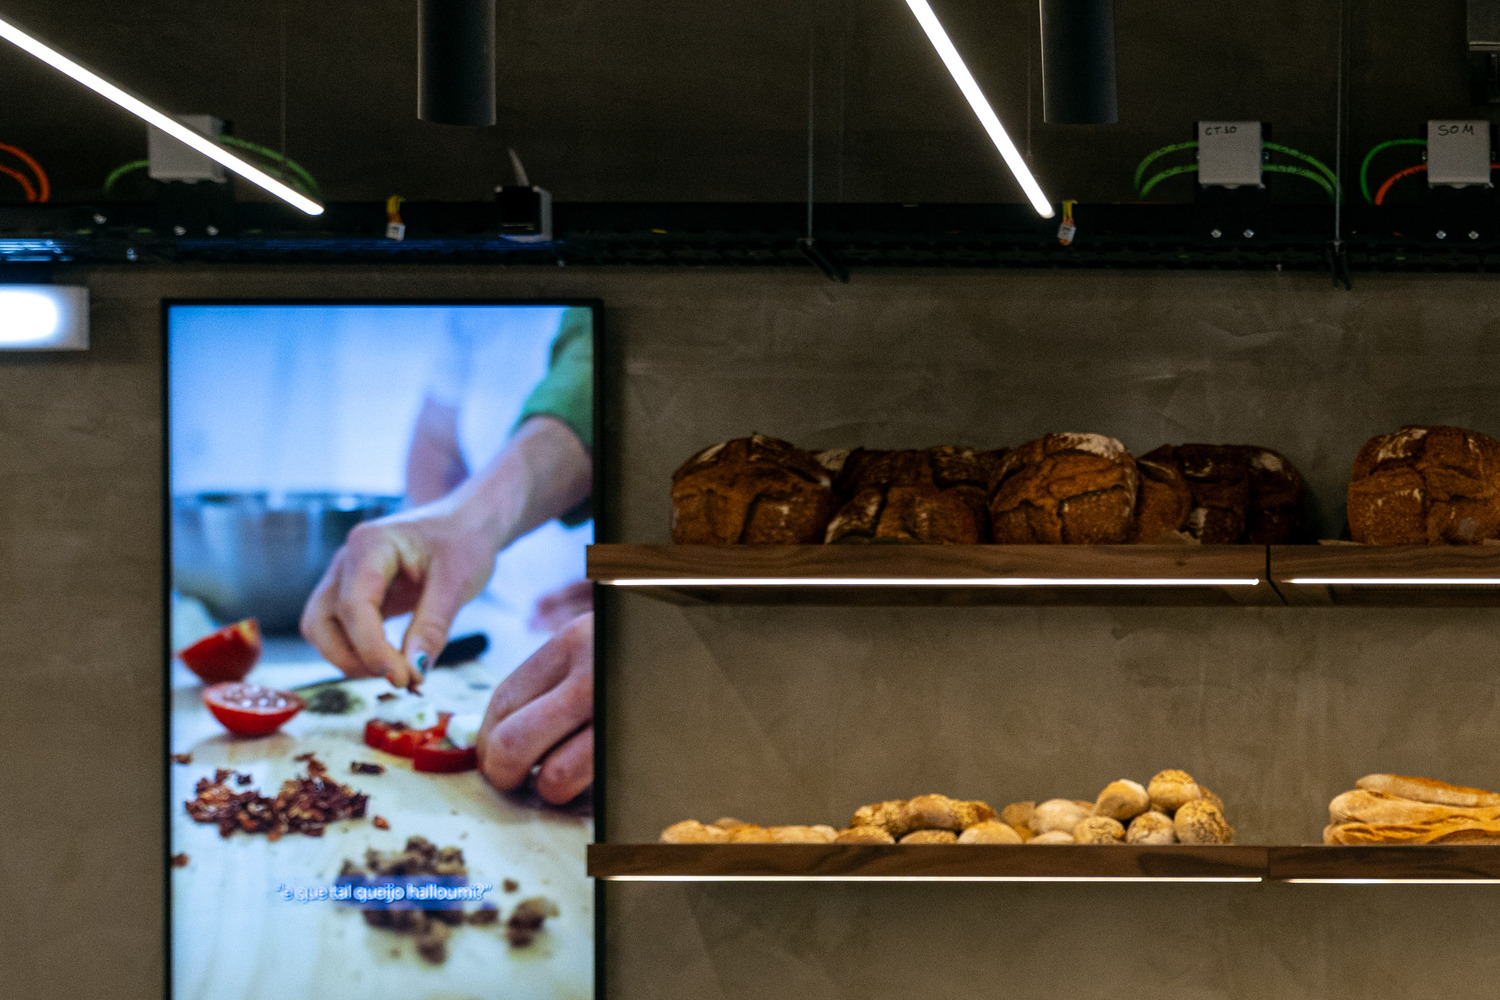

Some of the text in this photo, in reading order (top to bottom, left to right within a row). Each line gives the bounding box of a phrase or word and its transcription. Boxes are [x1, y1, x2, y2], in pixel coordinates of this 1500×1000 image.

[295, 886, 328, 903] que
[330, 883, 352, 900] tal
[353, 882, 405, 903] queijo
